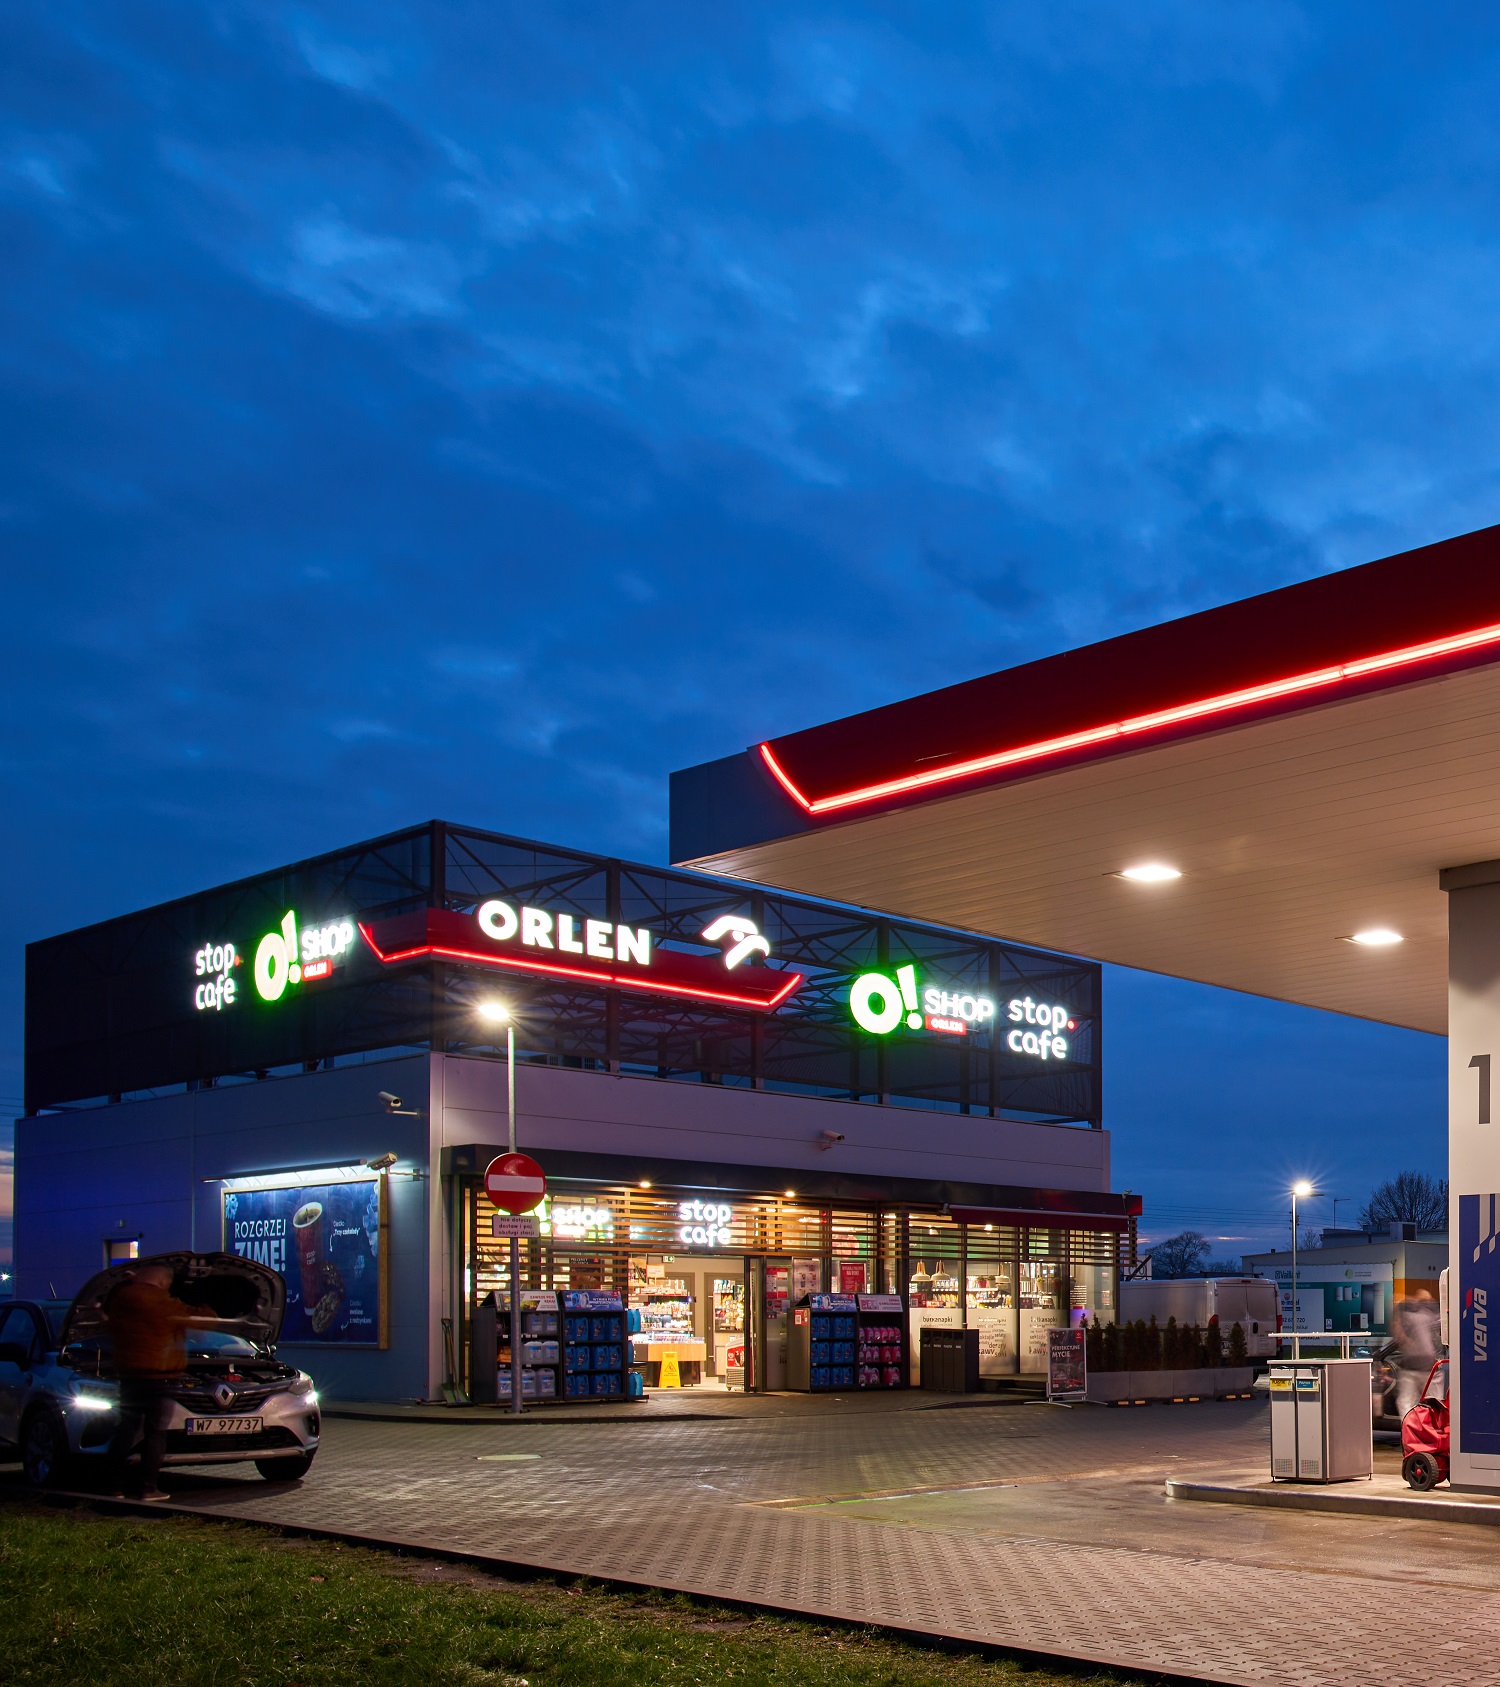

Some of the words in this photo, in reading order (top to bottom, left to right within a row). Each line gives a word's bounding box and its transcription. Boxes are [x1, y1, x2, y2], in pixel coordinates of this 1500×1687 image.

[478, 899, 650, 966] ORLEN
[254, 909, 301, 1001] O!
[301, 922, 354, 961] SHOP
[303, 961, 327, 978] ORLEN
[195, 974, 236, 1011] cafe
[849, 964, 923, 1035] O!
[924, 988, 995, 1023] SHOP
[930, 1019, 964, 1033] ORLEN
[1008, 1029, 1067, 1060] cafe
[1467, 1053, 1491, 1125] 1
[234, 1218, 286, 1239] ROZGRZEJ
[679, 1223, 732, 1248] cafe
[1280, 1270, 1302, 1279] Vaillnt
[1473, 1287, 1487, 1362] verva
[1051, 1350, 1071, 1358] MYCIE
[196, 1419, 213, 1431] W7
[218, 1419, 260, 1431] 97737
